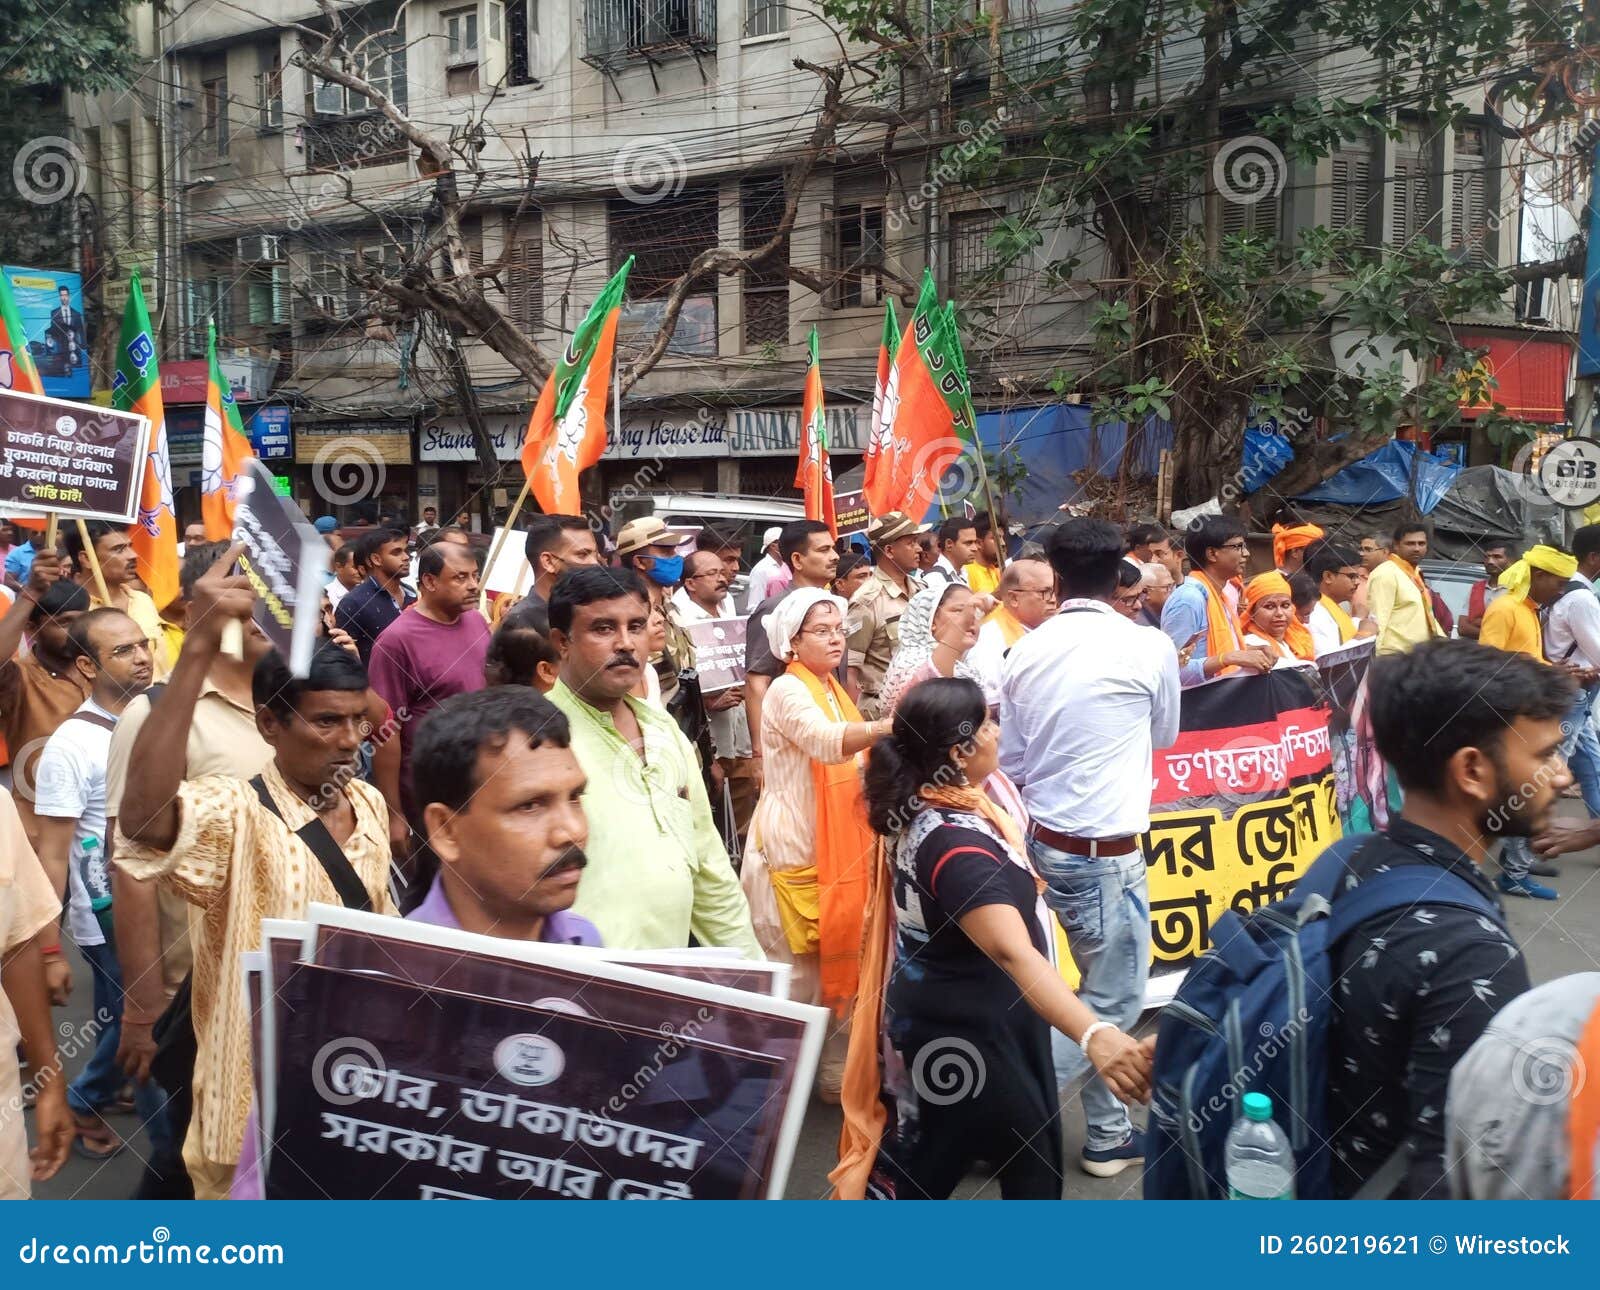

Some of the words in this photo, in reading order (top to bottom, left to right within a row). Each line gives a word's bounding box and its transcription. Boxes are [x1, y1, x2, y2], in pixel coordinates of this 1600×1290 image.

[7, 431, 45, 447] চাকরি
[47, 435, 74, 453] নিয়ে
[76, 442, 116, 459] বাংলার
[423, 424, 508, 452] Standrd
[647, 419, 696, 446] House
[4, 447, 70, 468] যুবসমাজের
[16, 466, 58, 483] করলো
[59, 472, 84, 487] যারা
[85, 476, 119, 491] তাদের
[1165, 742, 1285, 793] তৃণমূলমু
[460, 1085, 704, 1172] ডাকাতদের
[321, 1111, 490, 1174] সরকার
[497, 1149, 602, 1200] আর
